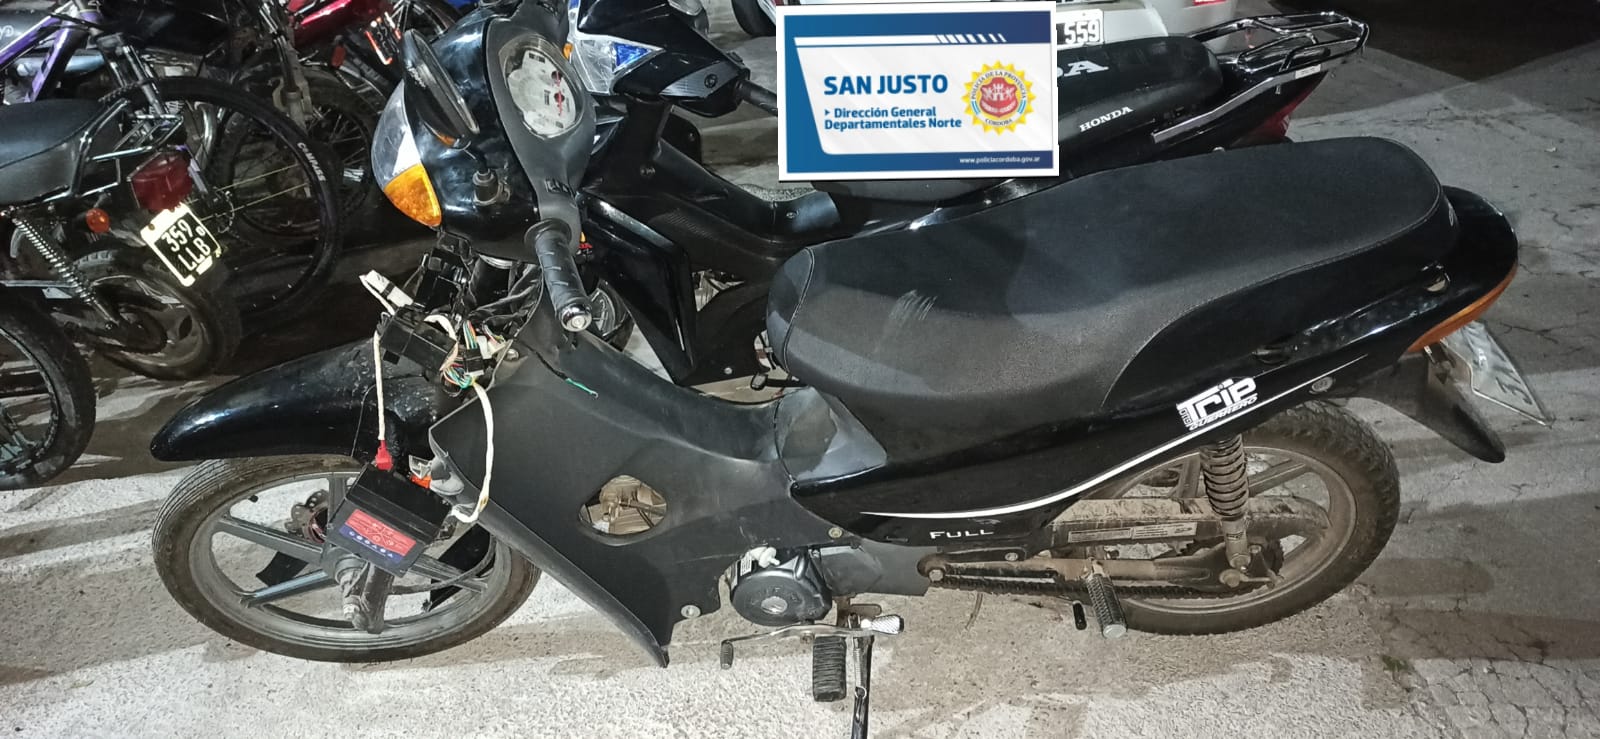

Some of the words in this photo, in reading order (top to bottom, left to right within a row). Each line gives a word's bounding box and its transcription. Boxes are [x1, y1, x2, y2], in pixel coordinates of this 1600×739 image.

[1064, 19, 1100, 45] 559
[1079, 106, 1134, 132] HONDA
[161, 218, 194, 252] 359
[177, 237, 211, 272] LLB
[929, 529, 995, 540] FULL
